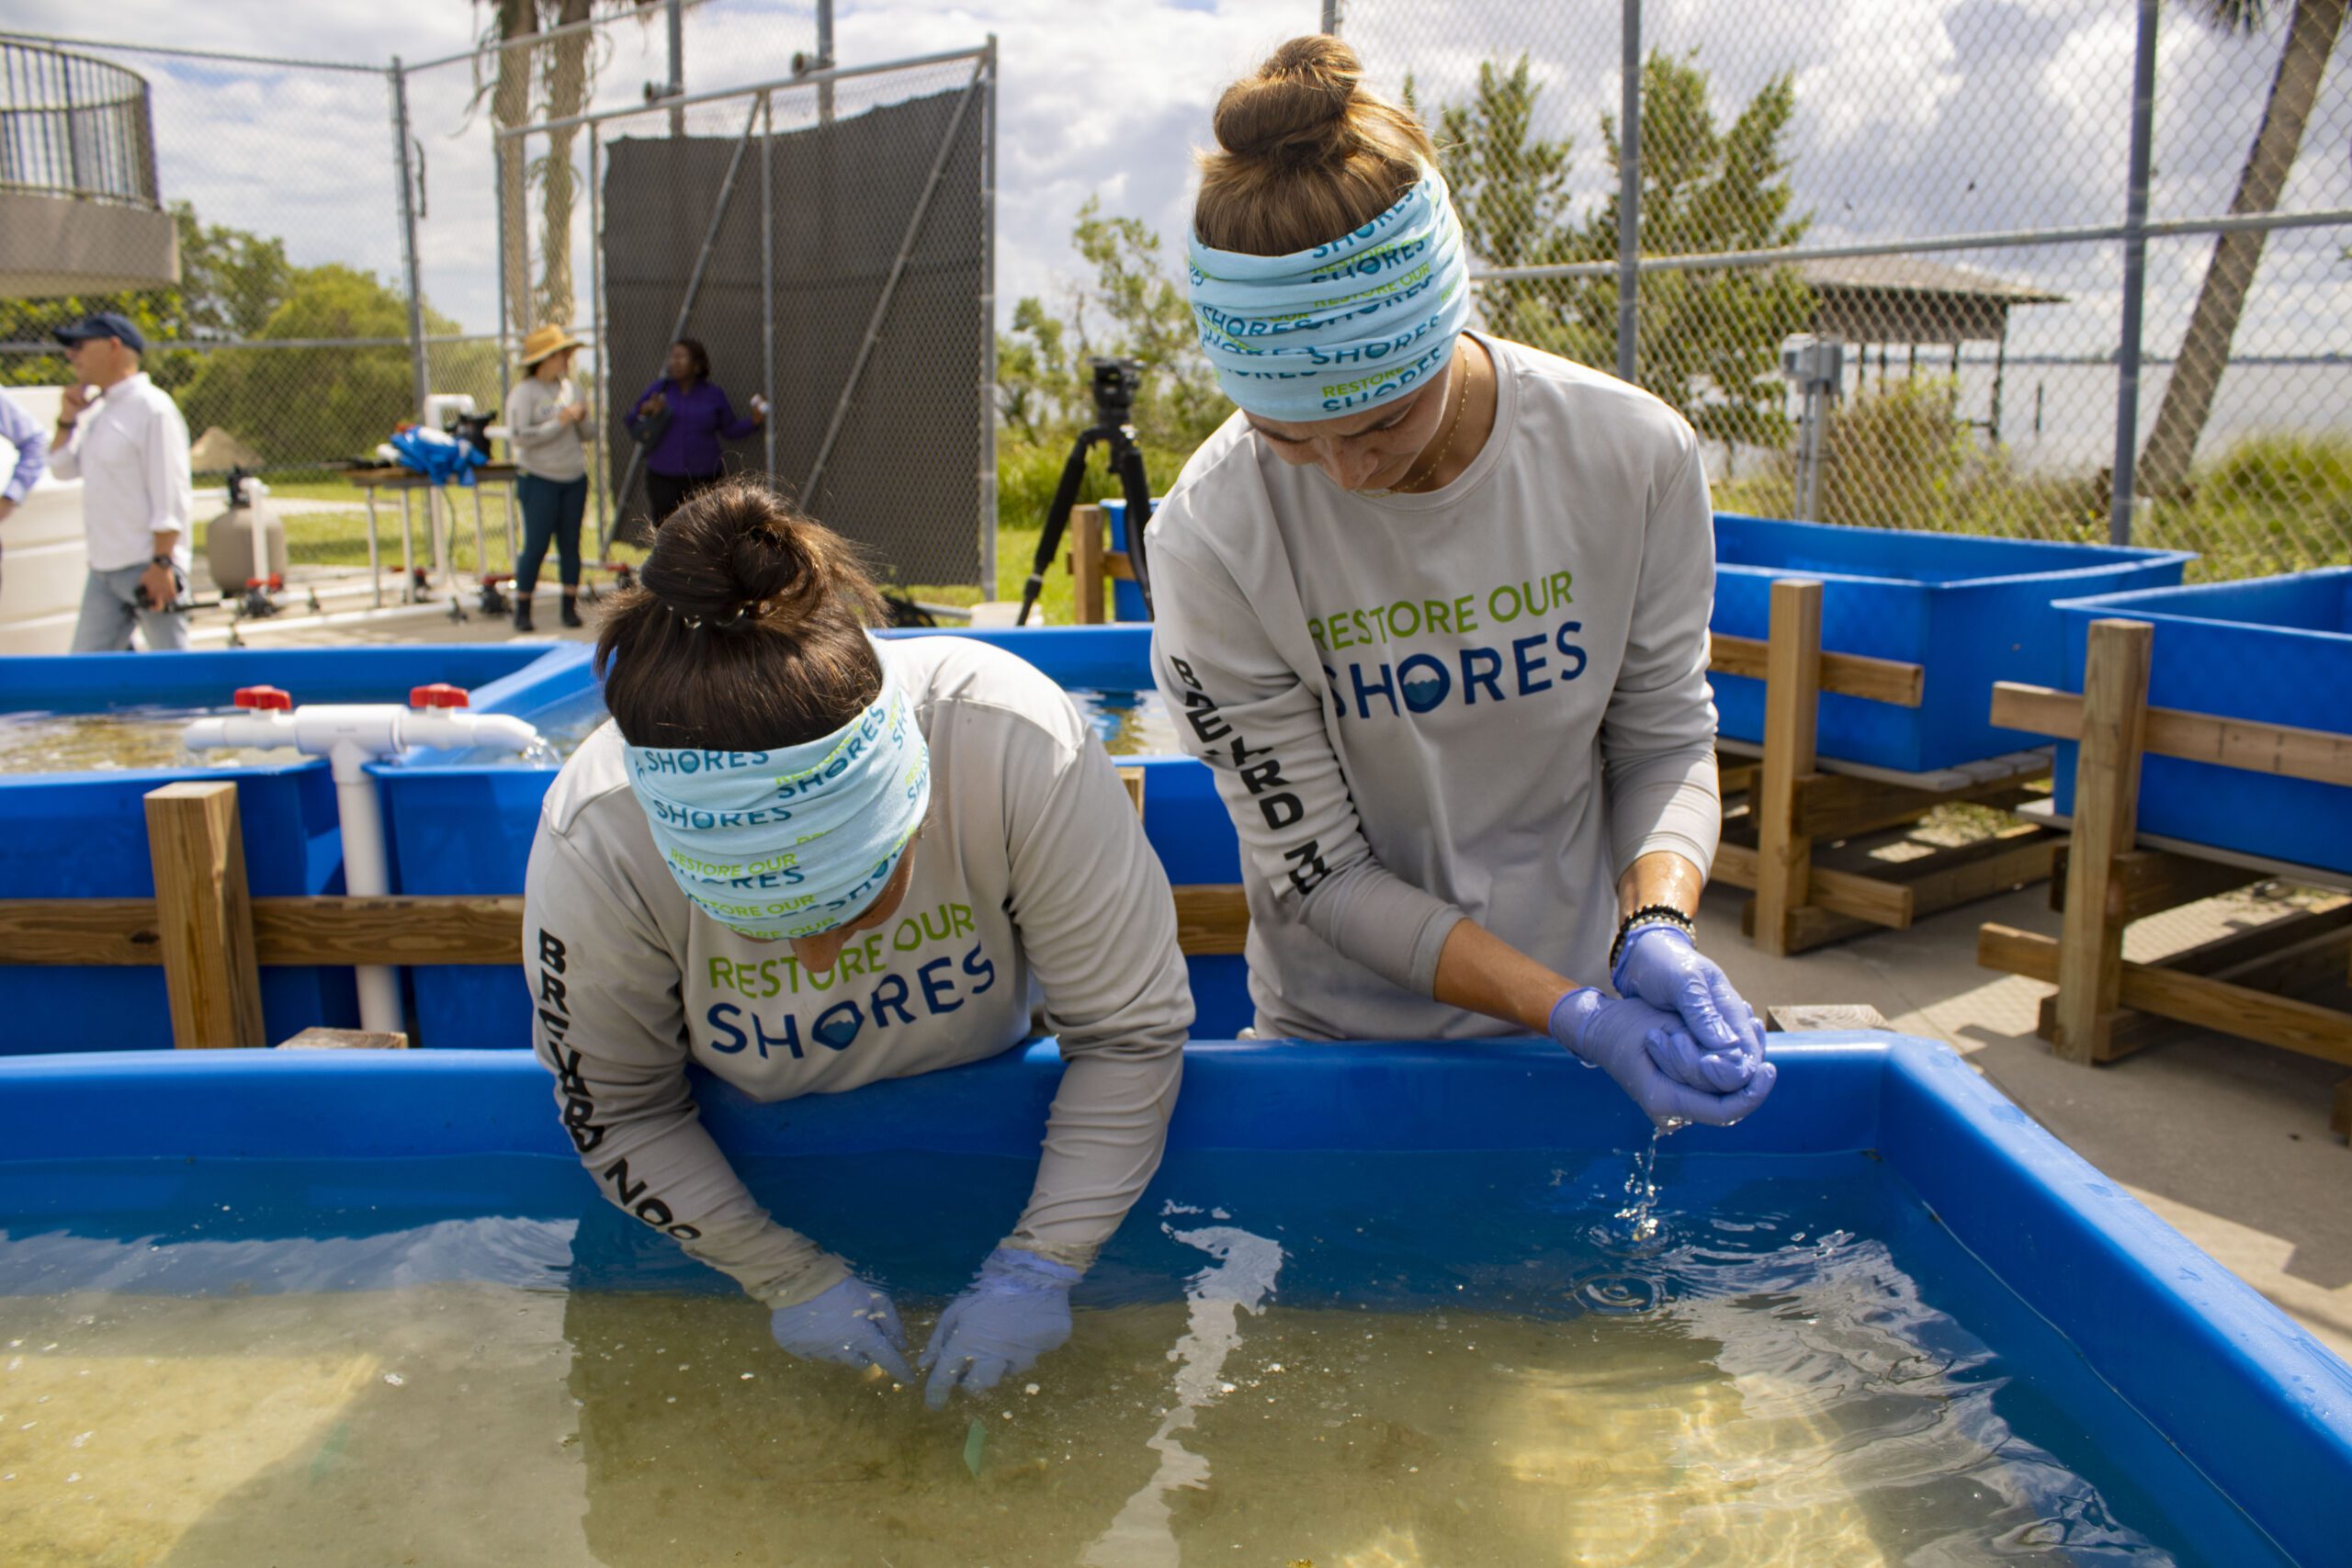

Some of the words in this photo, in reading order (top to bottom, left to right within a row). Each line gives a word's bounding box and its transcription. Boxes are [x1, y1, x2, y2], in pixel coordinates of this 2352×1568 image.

[1306, 593, 1478, 651] RESTORE
[1488, 570, 1574, 623] OUR
[1322, 621, 1588, 718] SHORES
[645, 749, 769, 774] SHORES
[778, 705, 886, 799] SHORES
[653, 799, 792, 829] SHORES
[671, 848, 741, 877] RESTORE
[748, 852, 797, 875] OUR
[766, 894, 815, 914] OUR
[707, 932, 887, 999] RESTORE
[893, 903, 976, 951] OUR
[707, 939, 995, 1060] SHORES
